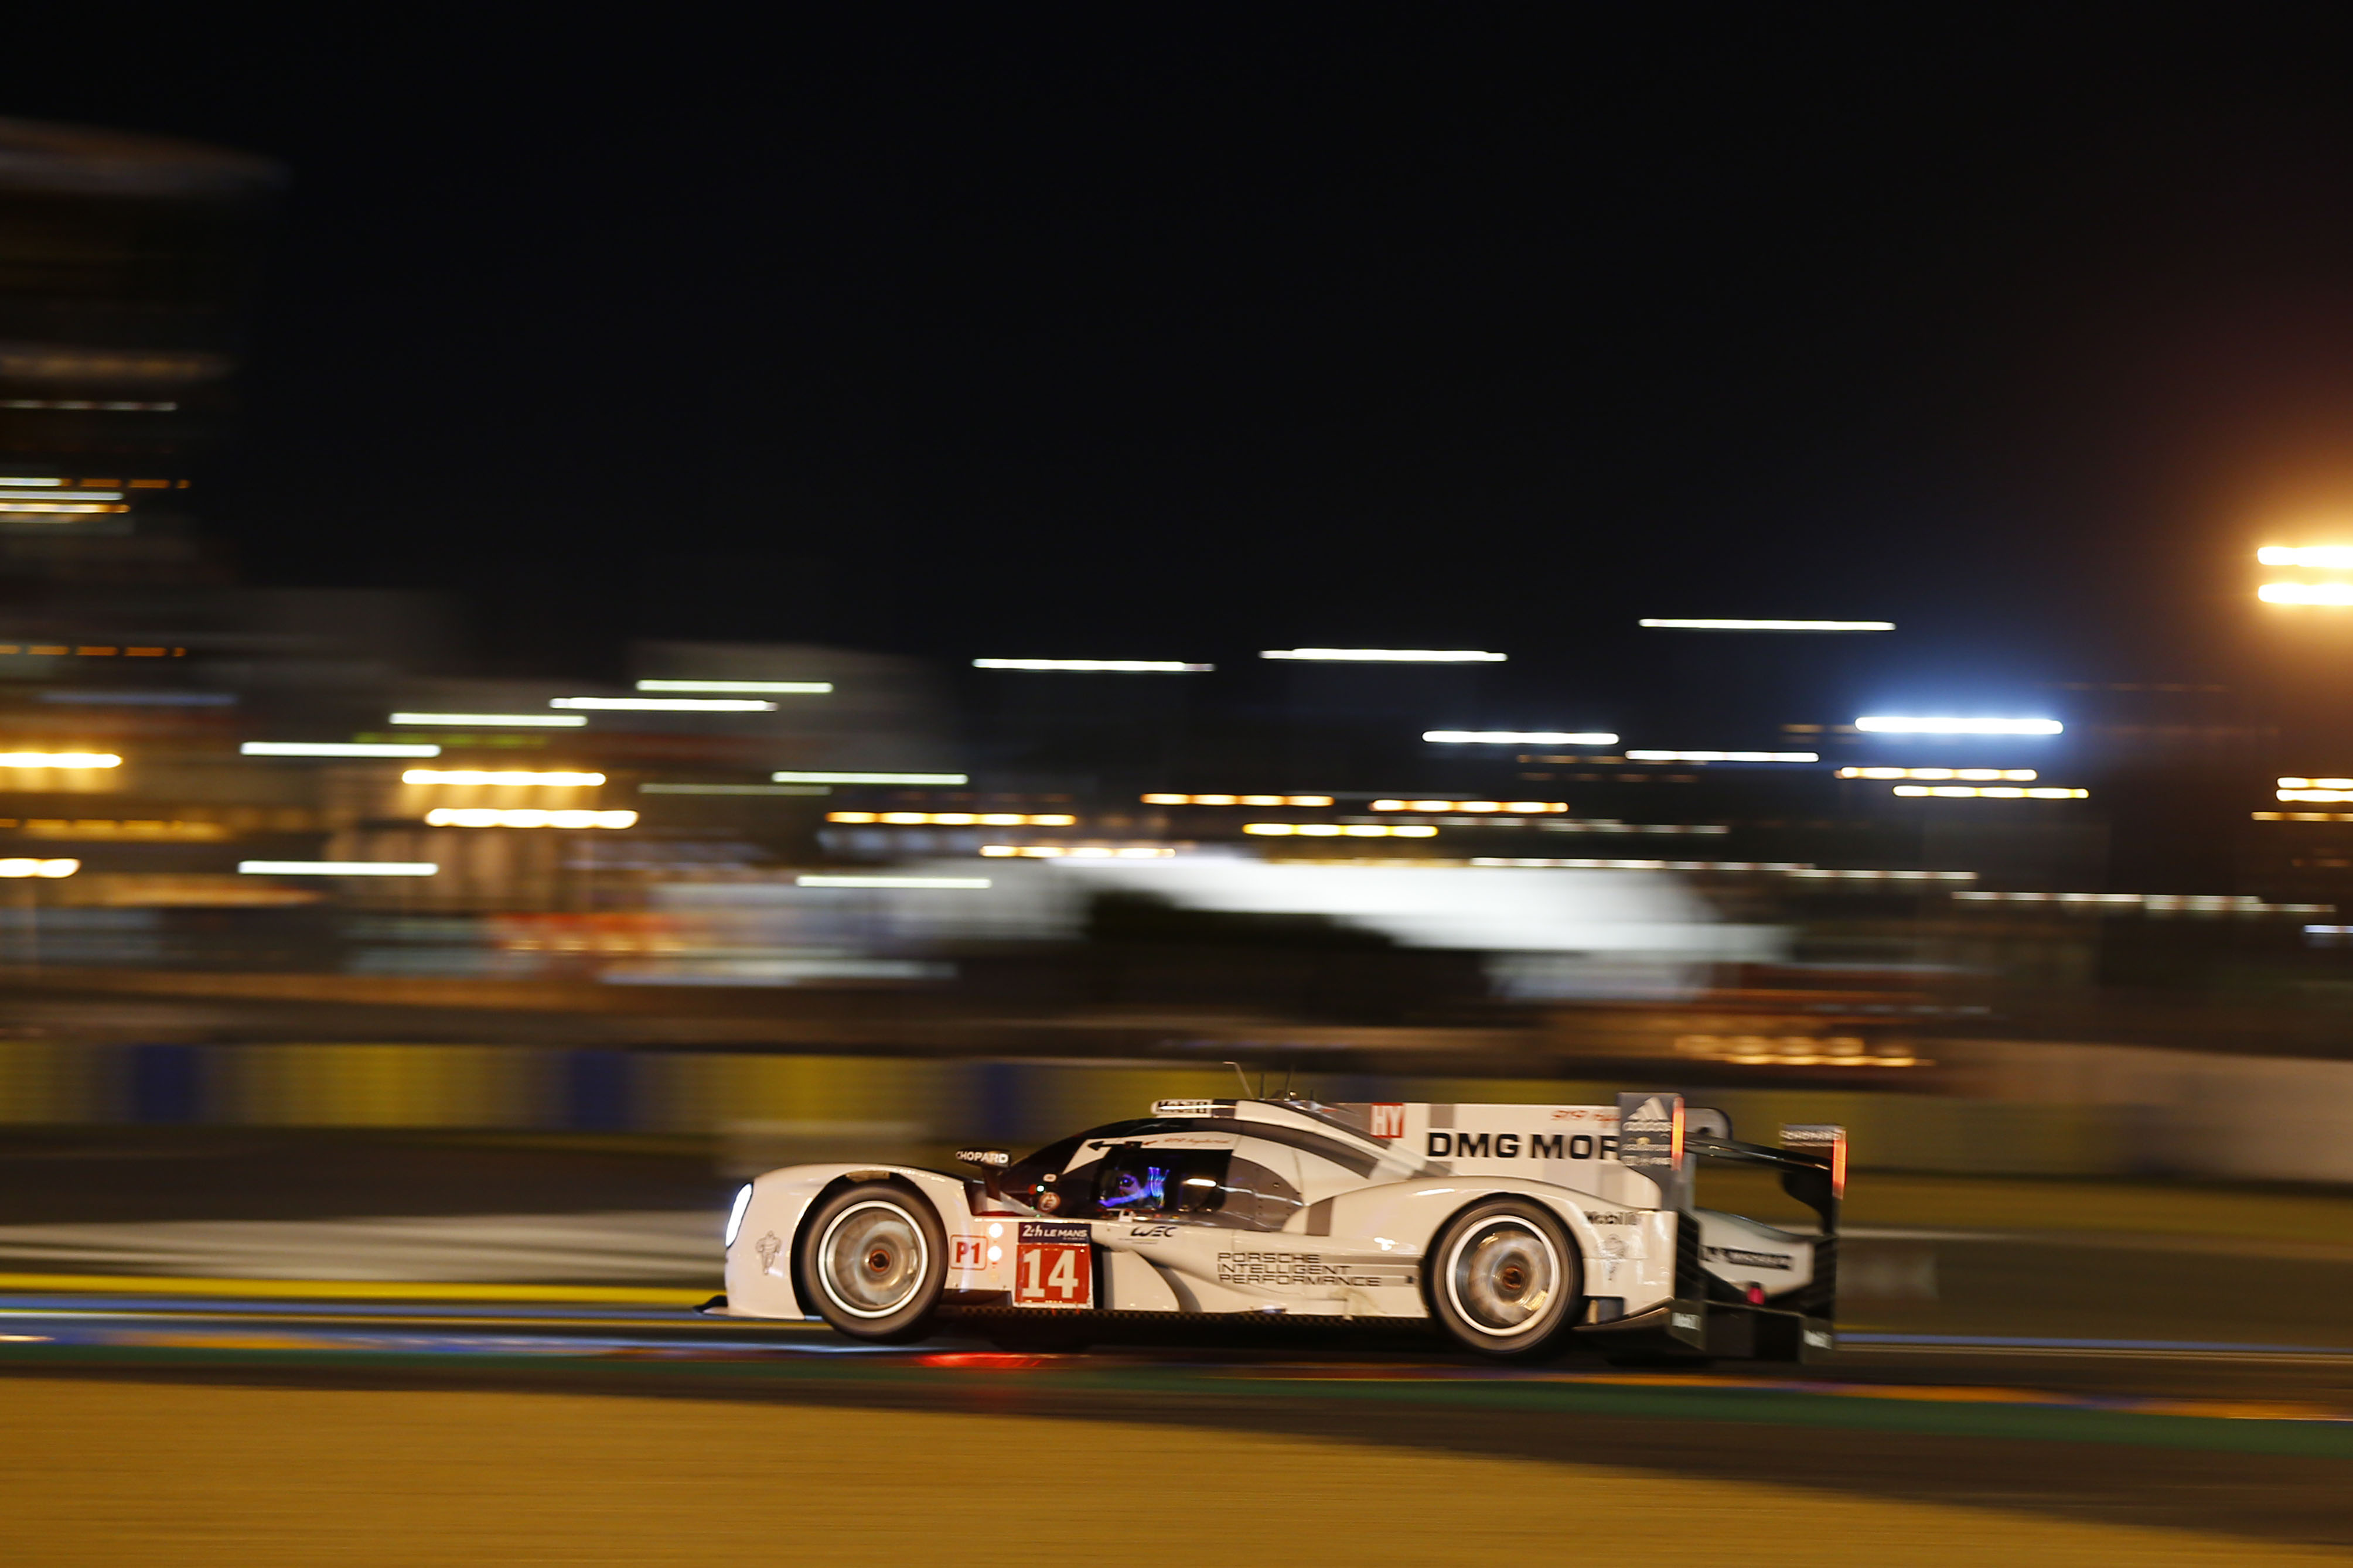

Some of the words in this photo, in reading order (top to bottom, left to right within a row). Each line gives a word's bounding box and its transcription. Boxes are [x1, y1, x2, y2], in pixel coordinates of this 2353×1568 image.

[1372, 1105, 1405, 1135] HY
[1428, 1132, 1519, 1158] DMG
[956, 1150, 1009, 1164] CHOPARD
[1130, 1225, 1178, 1238] WEC
[956, 1242, 980, 1264] P1
[1218, 1252, 1320, 1264] PORSCHE
[1022, 1249, 1079, 1299] 14
[1218, 1263, 1351, 1275] INTELLIGENT
[1219, 1274, 1382, 1287] PERFORMANCE
